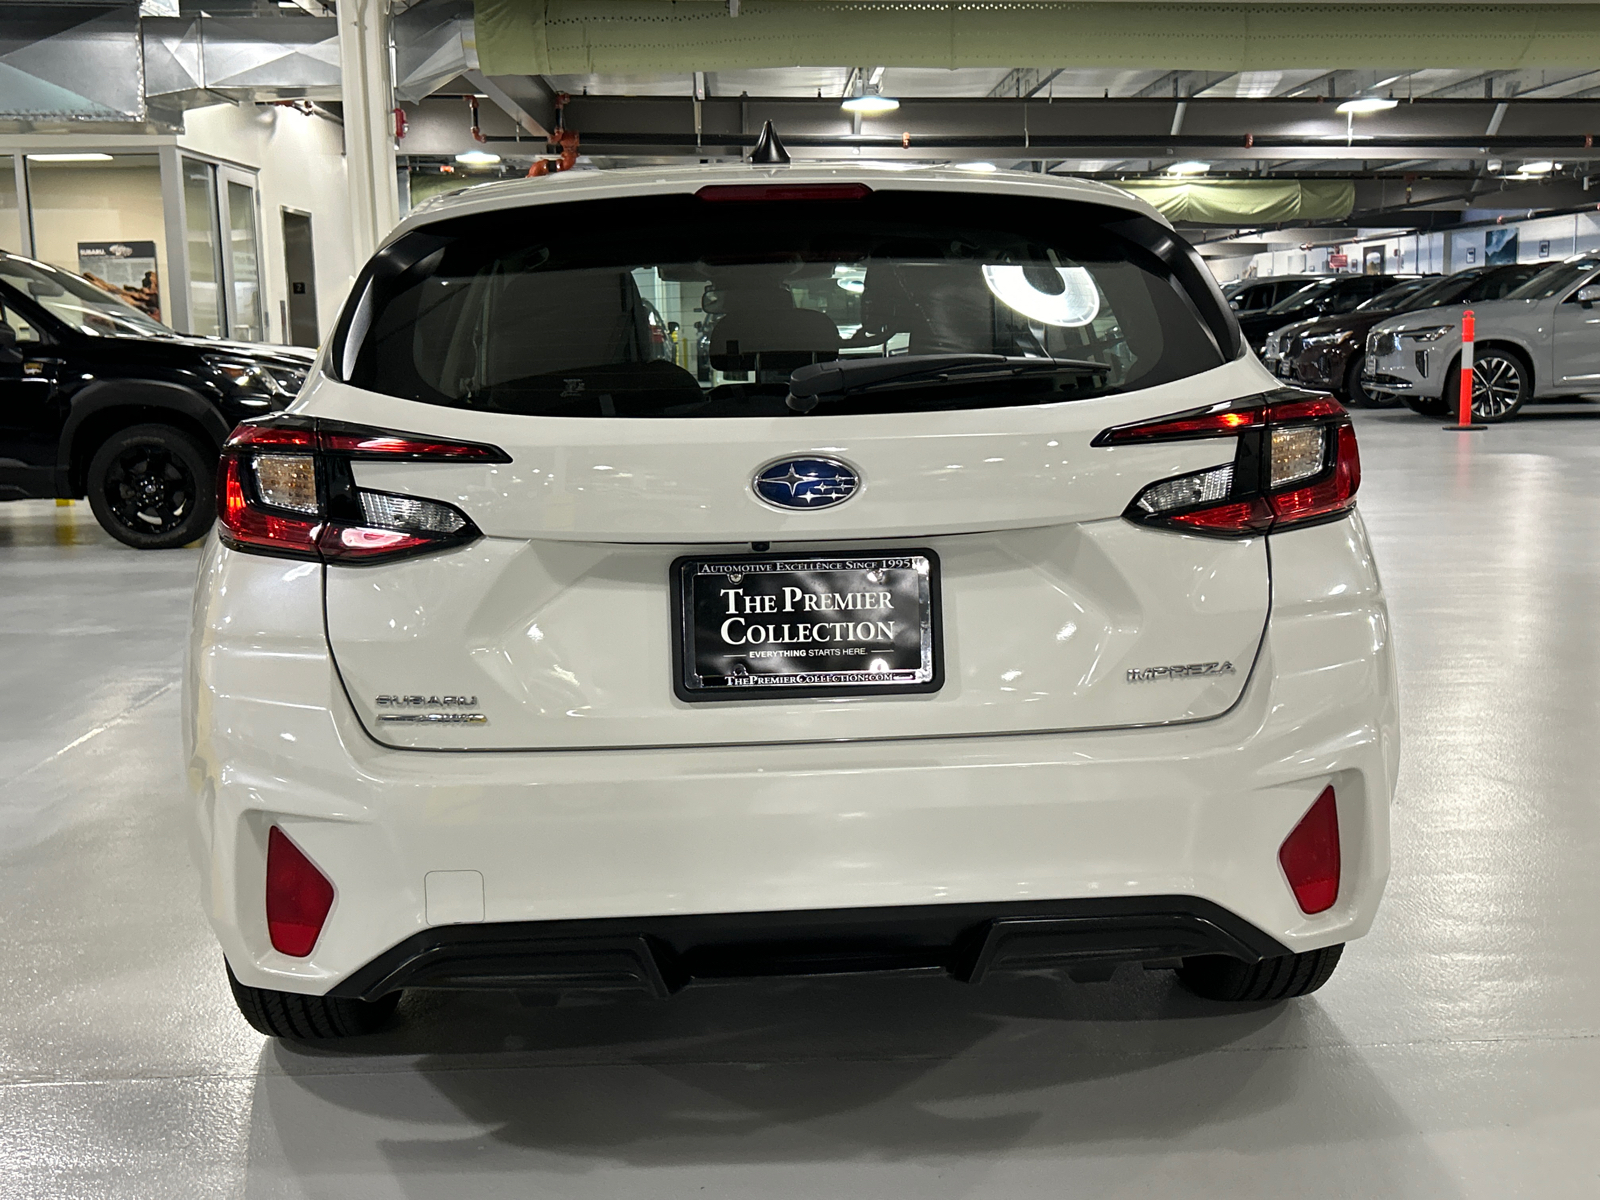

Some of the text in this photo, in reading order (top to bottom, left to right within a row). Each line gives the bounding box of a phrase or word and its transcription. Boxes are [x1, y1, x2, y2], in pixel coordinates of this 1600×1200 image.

[701, 558, 911, 574] AUTOMOTIVE EXCELLENCE SINCE 1995
[720, 586, 894, 614] THE PREMIER
[720, 617, 895, 646] COLLECTION
[749, 648, 868, 659] EVERYTHING STARTS HERE.
[1126, 660, 1233, 681] IMPREZA
[375, 695, 478, 707] SUBARU
